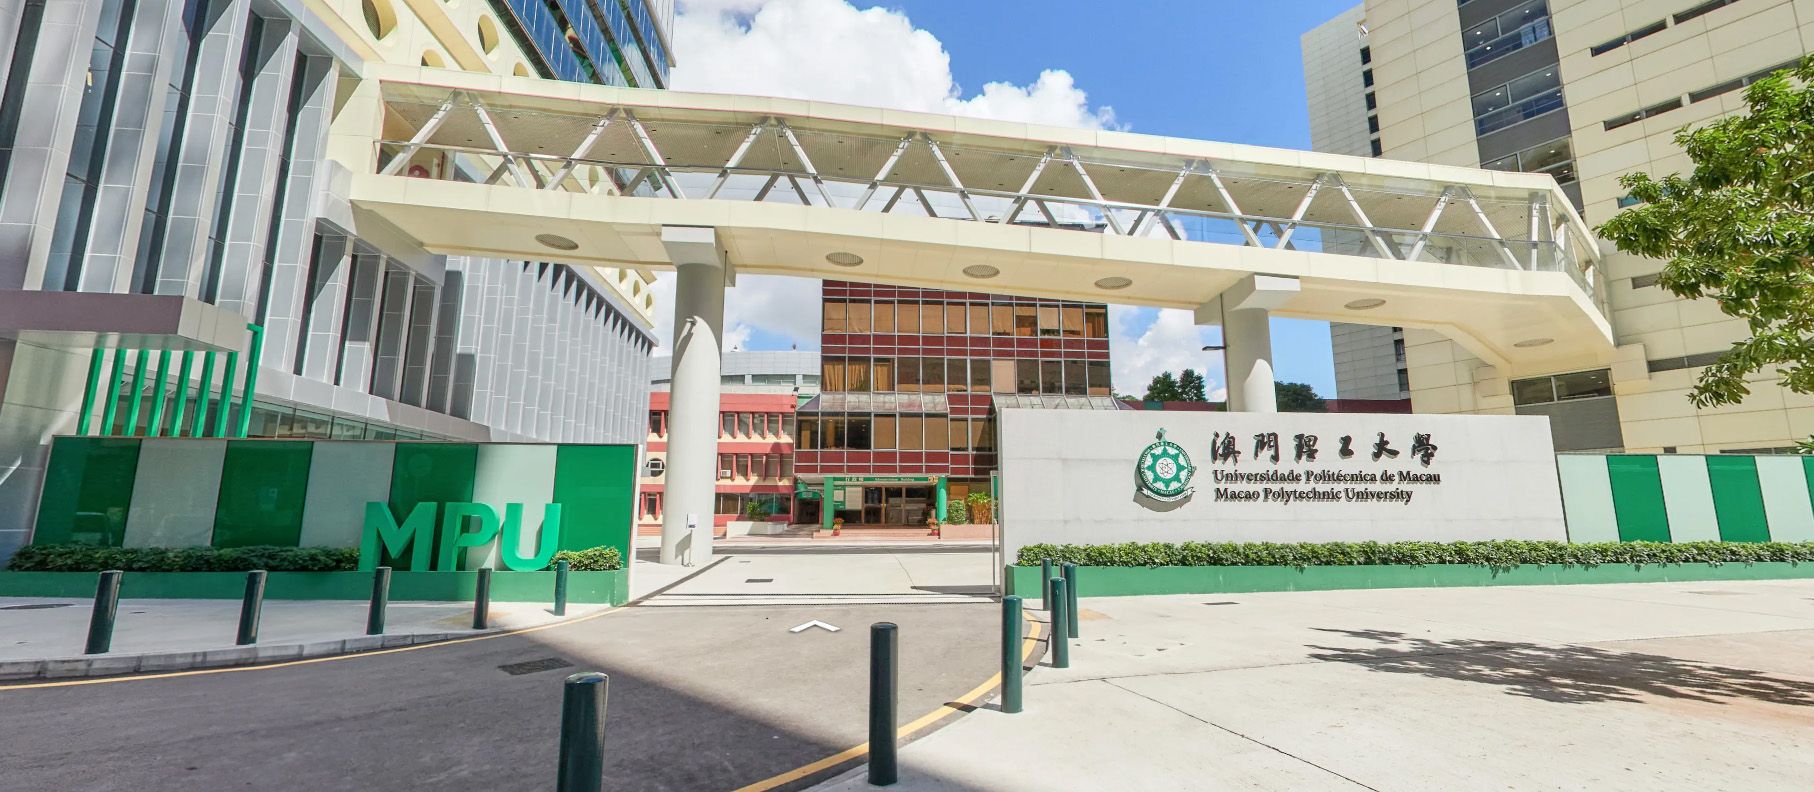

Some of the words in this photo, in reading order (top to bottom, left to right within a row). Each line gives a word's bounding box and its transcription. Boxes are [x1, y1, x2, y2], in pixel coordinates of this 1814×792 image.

[1211, 431, 1439, 466] 澳門理工大學
[1213, 469, 1302, 482] Universidade
[1305, 468, 1377, 482] Politécnica
[1380, 469, 1395, 482] de
[1397, 470, 1441, 482] Macau
[1215, 487, 1260, 500] Macao
[1263, 486, 1342, 503] Polytechnic
[1344, 487, 1413, 503] University
[358, 501, 562, 572] MPU
